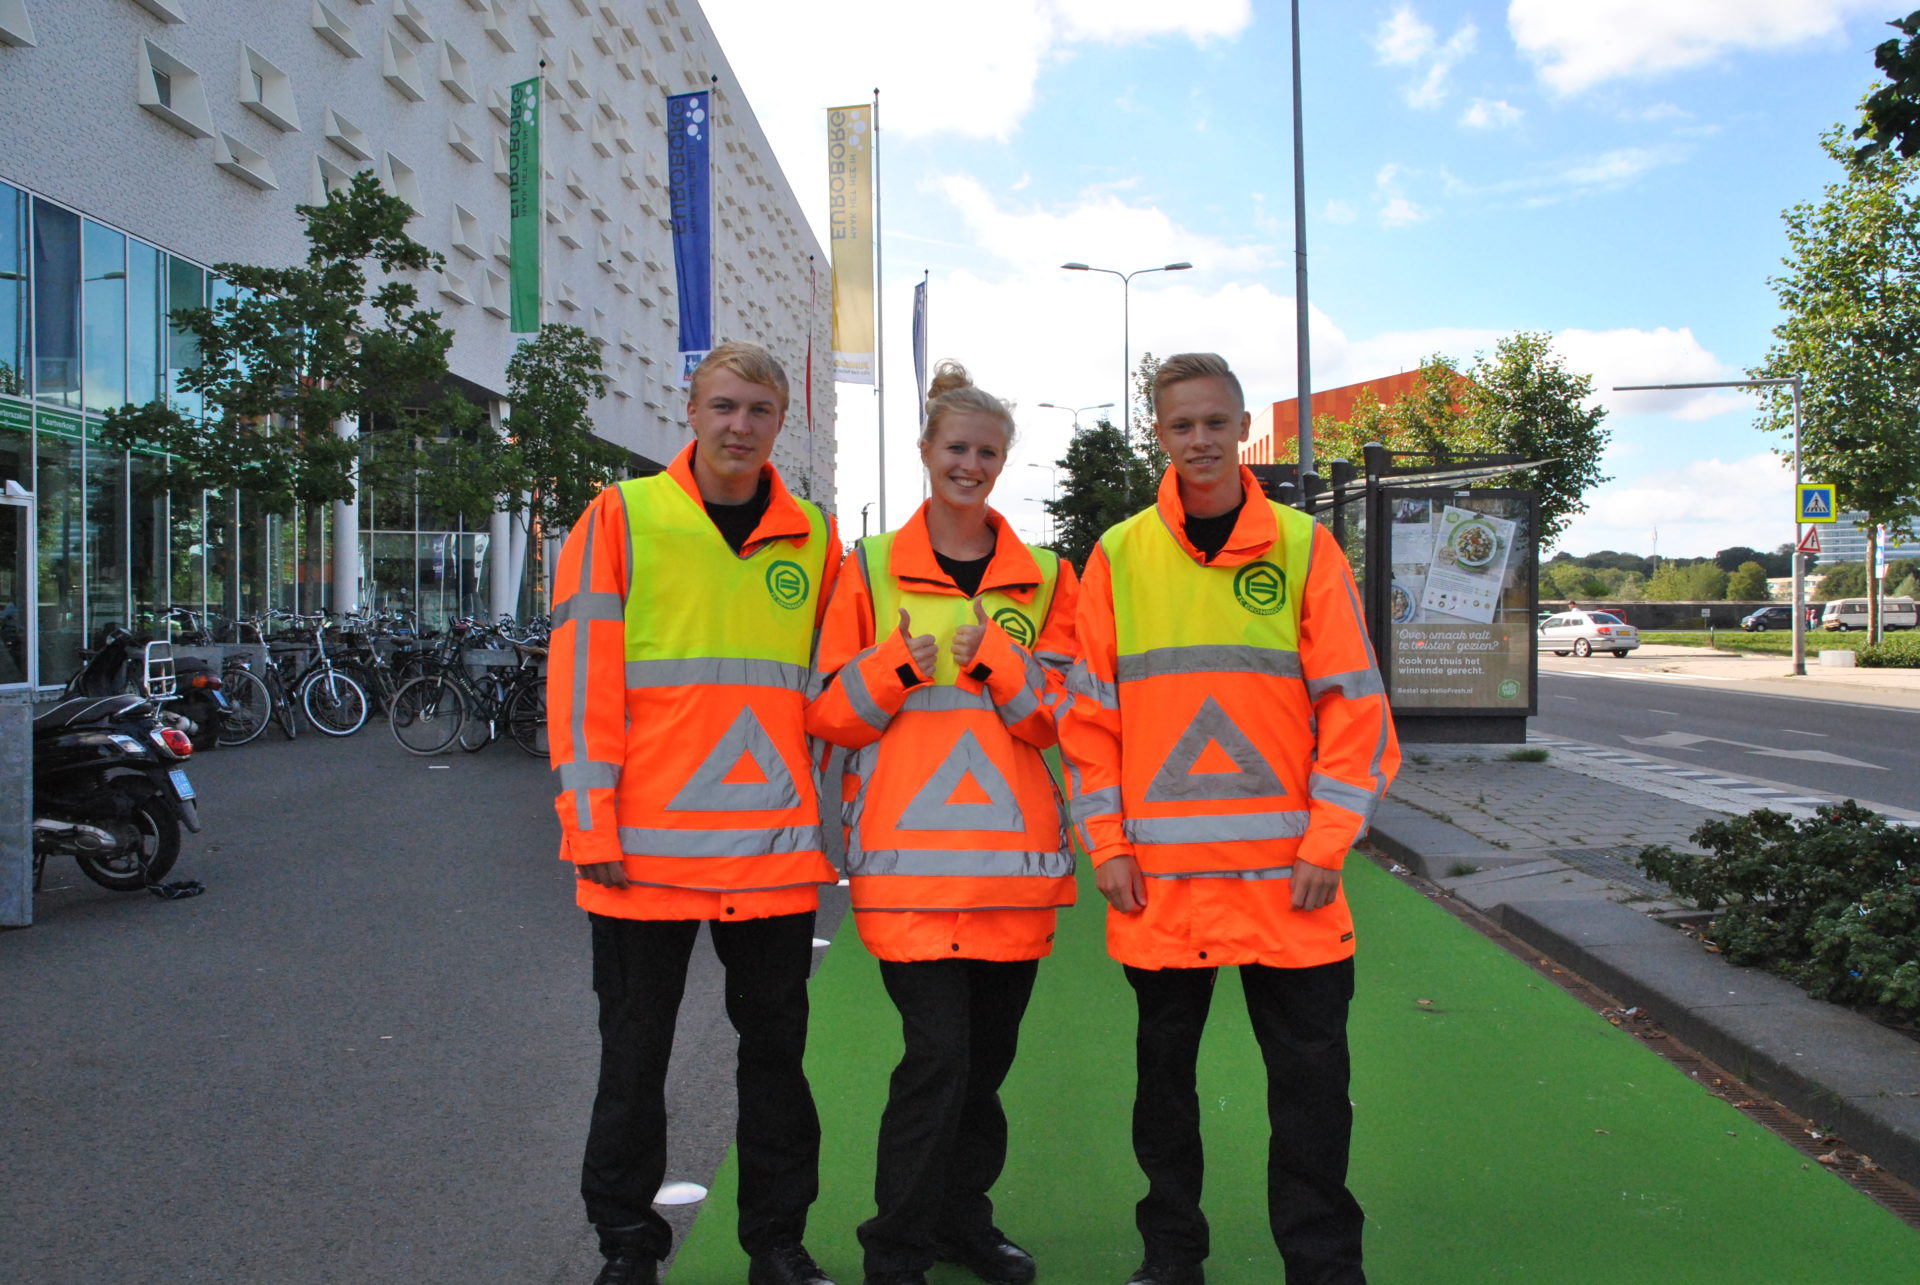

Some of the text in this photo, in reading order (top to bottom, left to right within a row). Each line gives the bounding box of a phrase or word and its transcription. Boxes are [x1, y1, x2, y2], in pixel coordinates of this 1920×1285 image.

[41, 416, 77, 432] Kaartverkoop
[1429, 630, 1466, 640] smaak
[1468, 630, 1491, 640] valt
[1398, 641, 1409, 650] te
[1456, 640, 1499, 654] gezien?
[1398, 656, 1422, 665] Kook
[1440, 656, 1462, 665] thuis
[1465, 657, 1480, 665] het
[1398, 666, 1485, 676] winnende gerecht.
